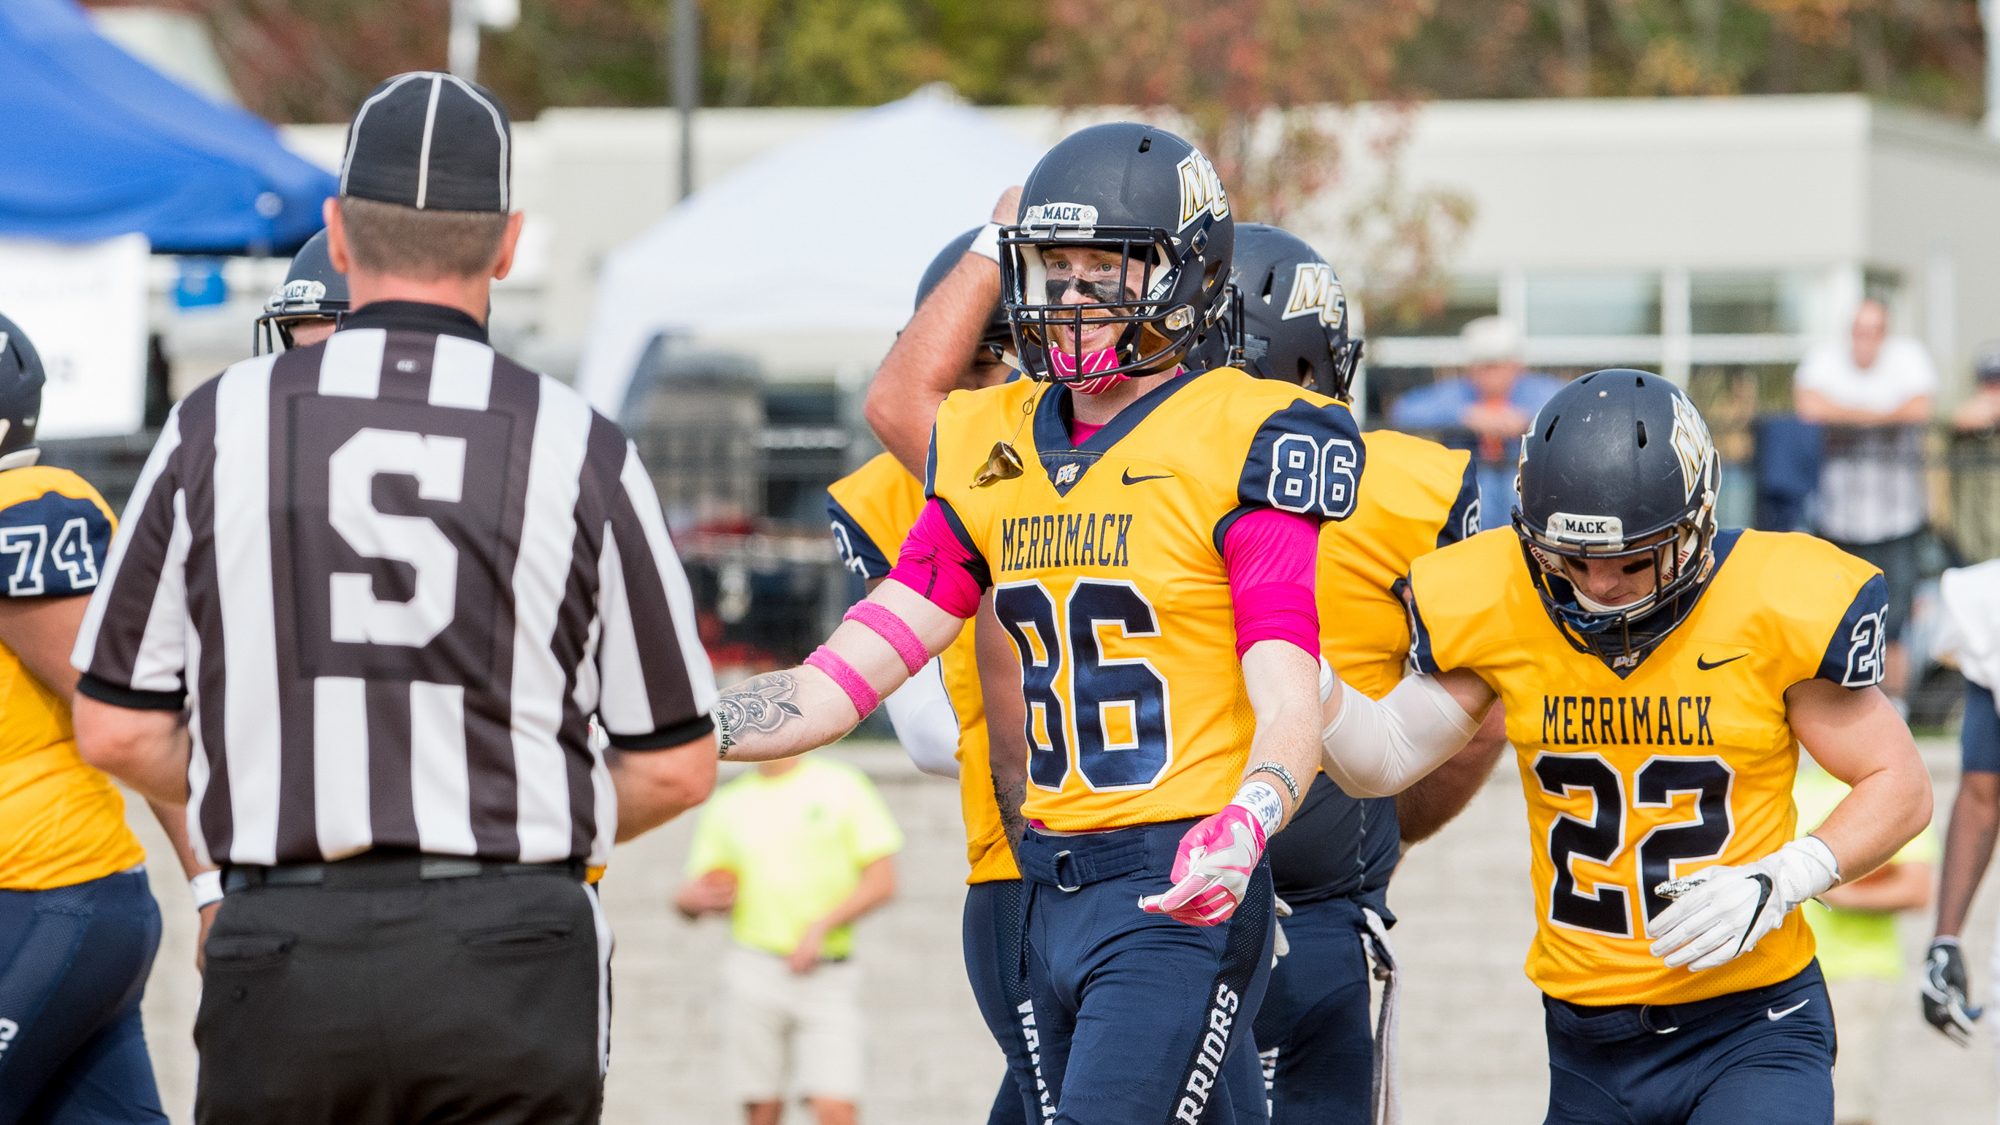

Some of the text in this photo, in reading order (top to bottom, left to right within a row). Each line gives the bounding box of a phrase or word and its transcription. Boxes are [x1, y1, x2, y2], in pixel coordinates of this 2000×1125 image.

[1042, 206, 1082, 221] MACK
[1266, 432, 1357, 518] 86
[0, 517, 99, 597] 74
[328, 427, 467, 649] S
[1000, 513, 1133, 572] MERRIMACK
[1564, 519, 1607, 534] MACK
[993, 576, 1174, 794] 86
[716, 710, 730, 754] FEAR NONE
[1542, 695, 1714, 745] MERRIMACK
[1531, 750, 1736, 940] 22
